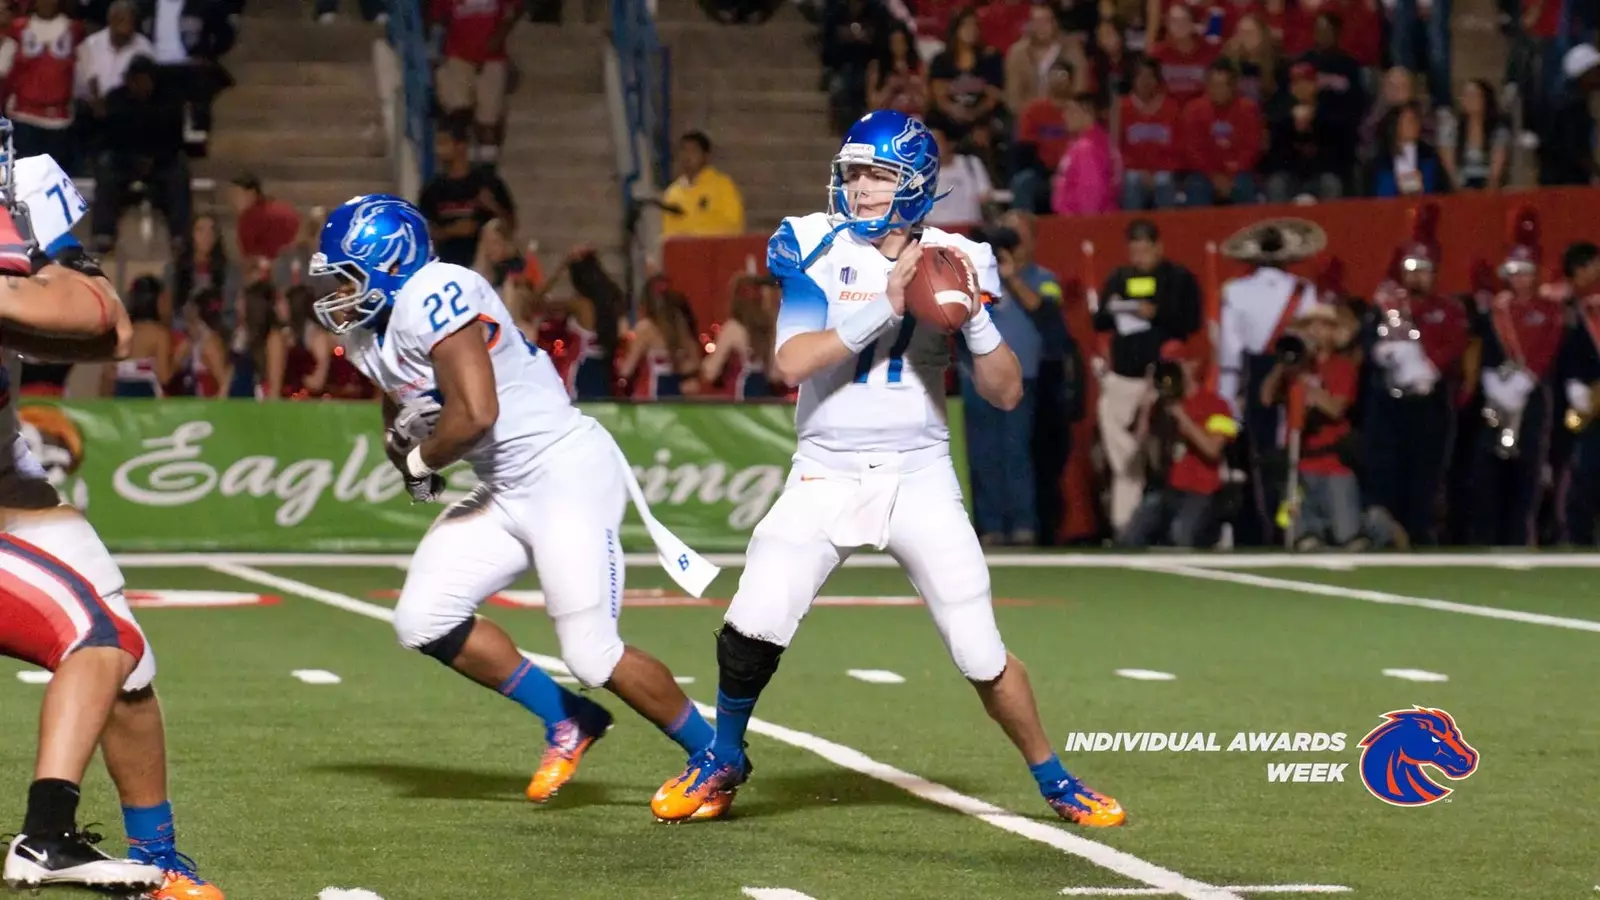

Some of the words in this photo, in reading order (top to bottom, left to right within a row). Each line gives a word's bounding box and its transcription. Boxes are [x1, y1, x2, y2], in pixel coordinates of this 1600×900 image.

[45, 177, 88, 225] 73
[423, 281, 470, 332] 22
[839, 291, 881, 301] BOIS
